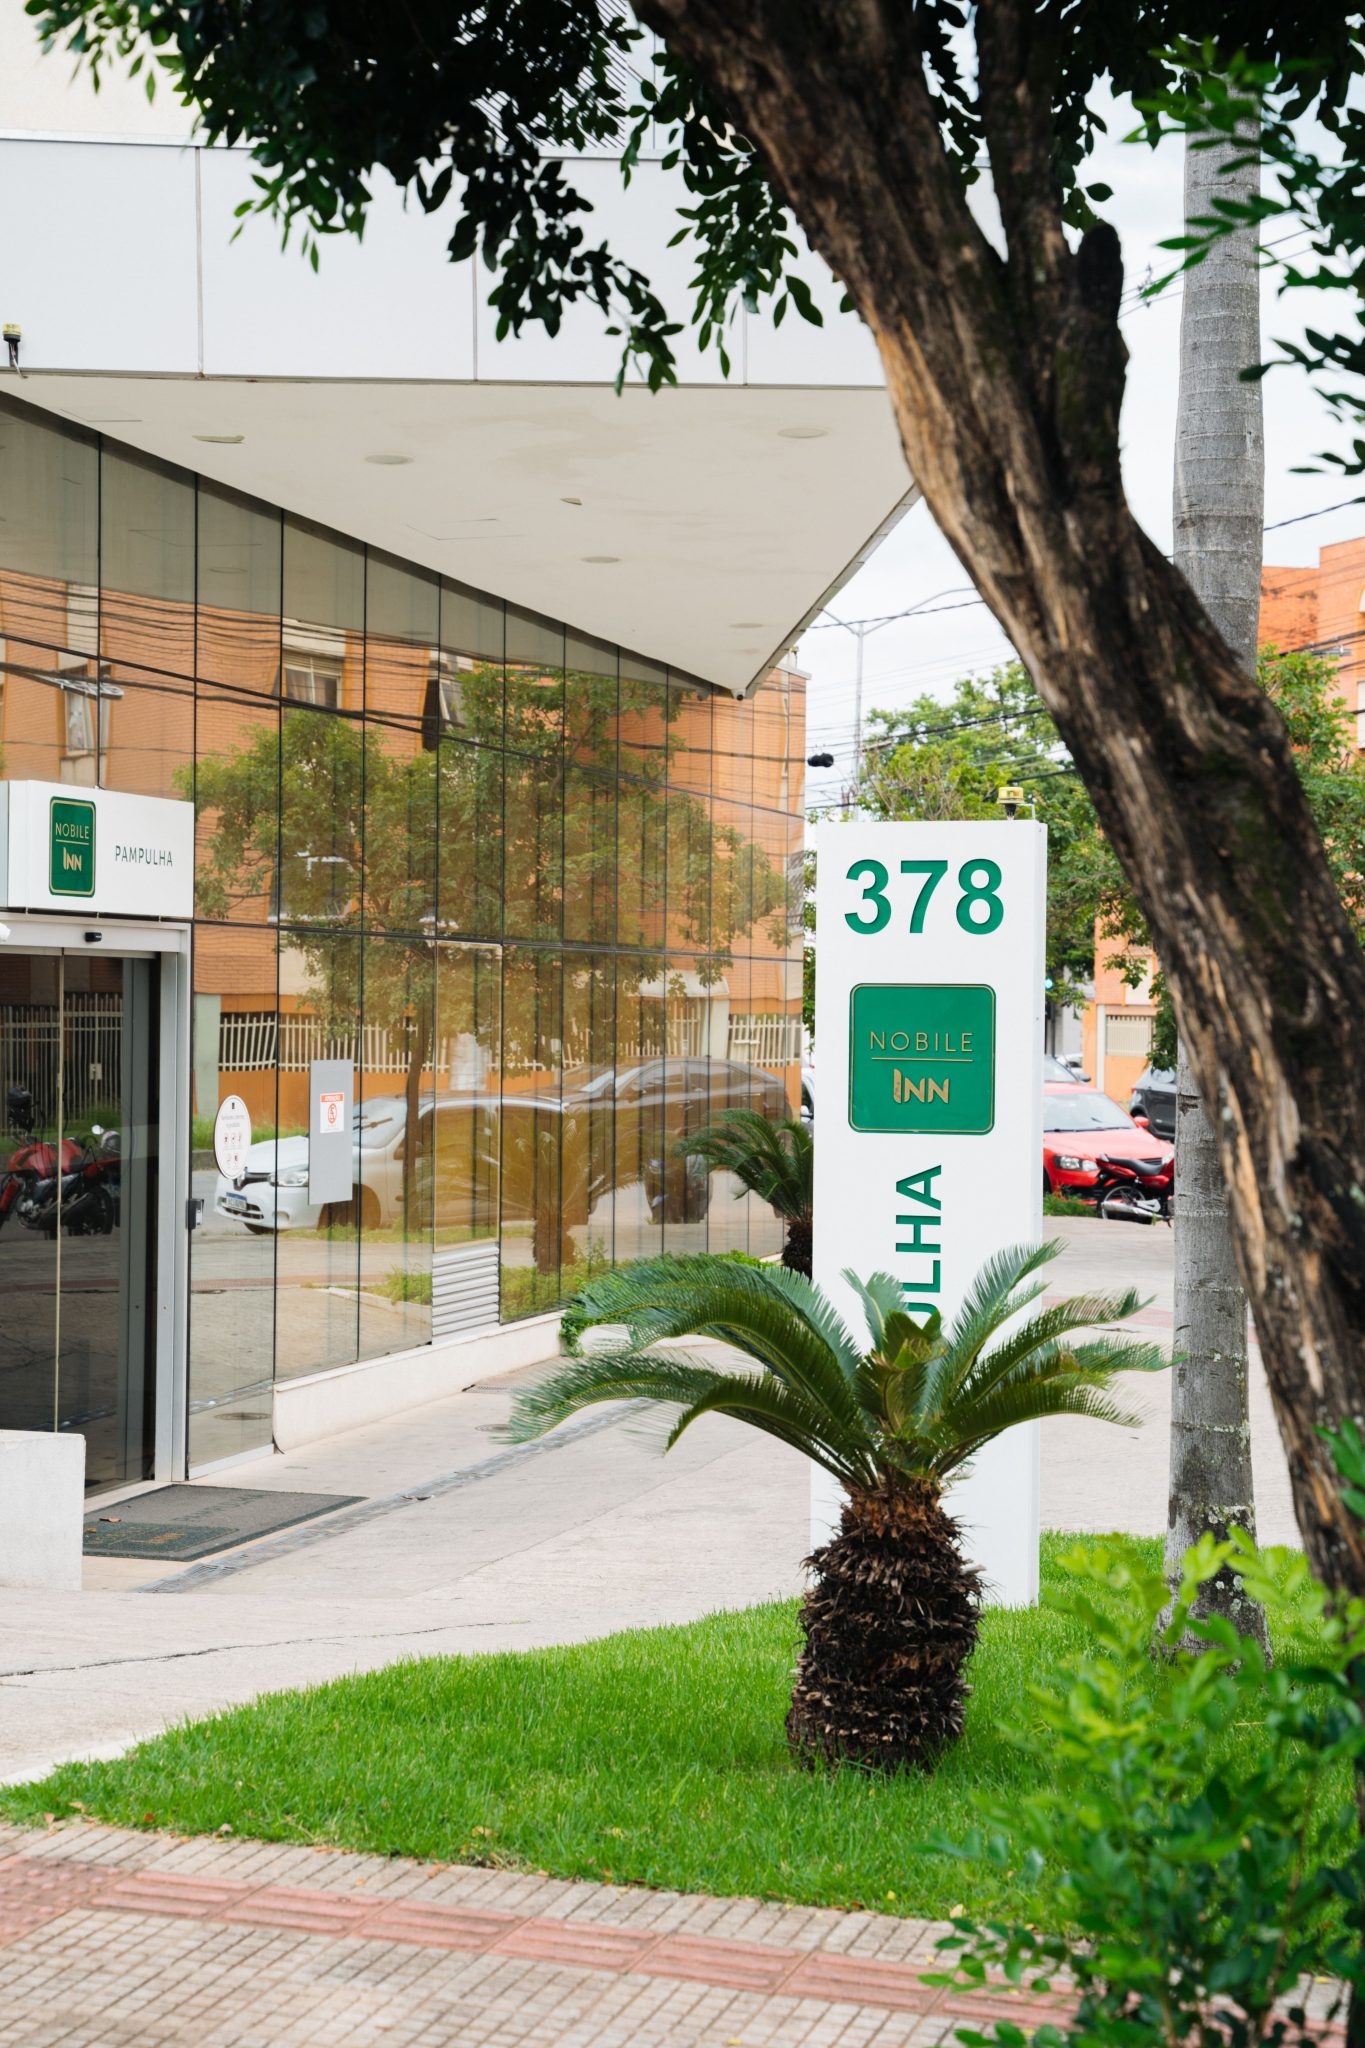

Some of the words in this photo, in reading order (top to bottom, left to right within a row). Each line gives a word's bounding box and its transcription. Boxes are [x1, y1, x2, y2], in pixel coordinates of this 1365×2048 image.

[55, 822, 90, 840] NOBILE
[63, 847, 82, 872] INN
[115, 845, 173, 867] PAMPULHA
[844, 858, 1005, 935] 378
[869, 1030, 974, 1052] NOBILE
[893, 1068, 950, 1104] INN
